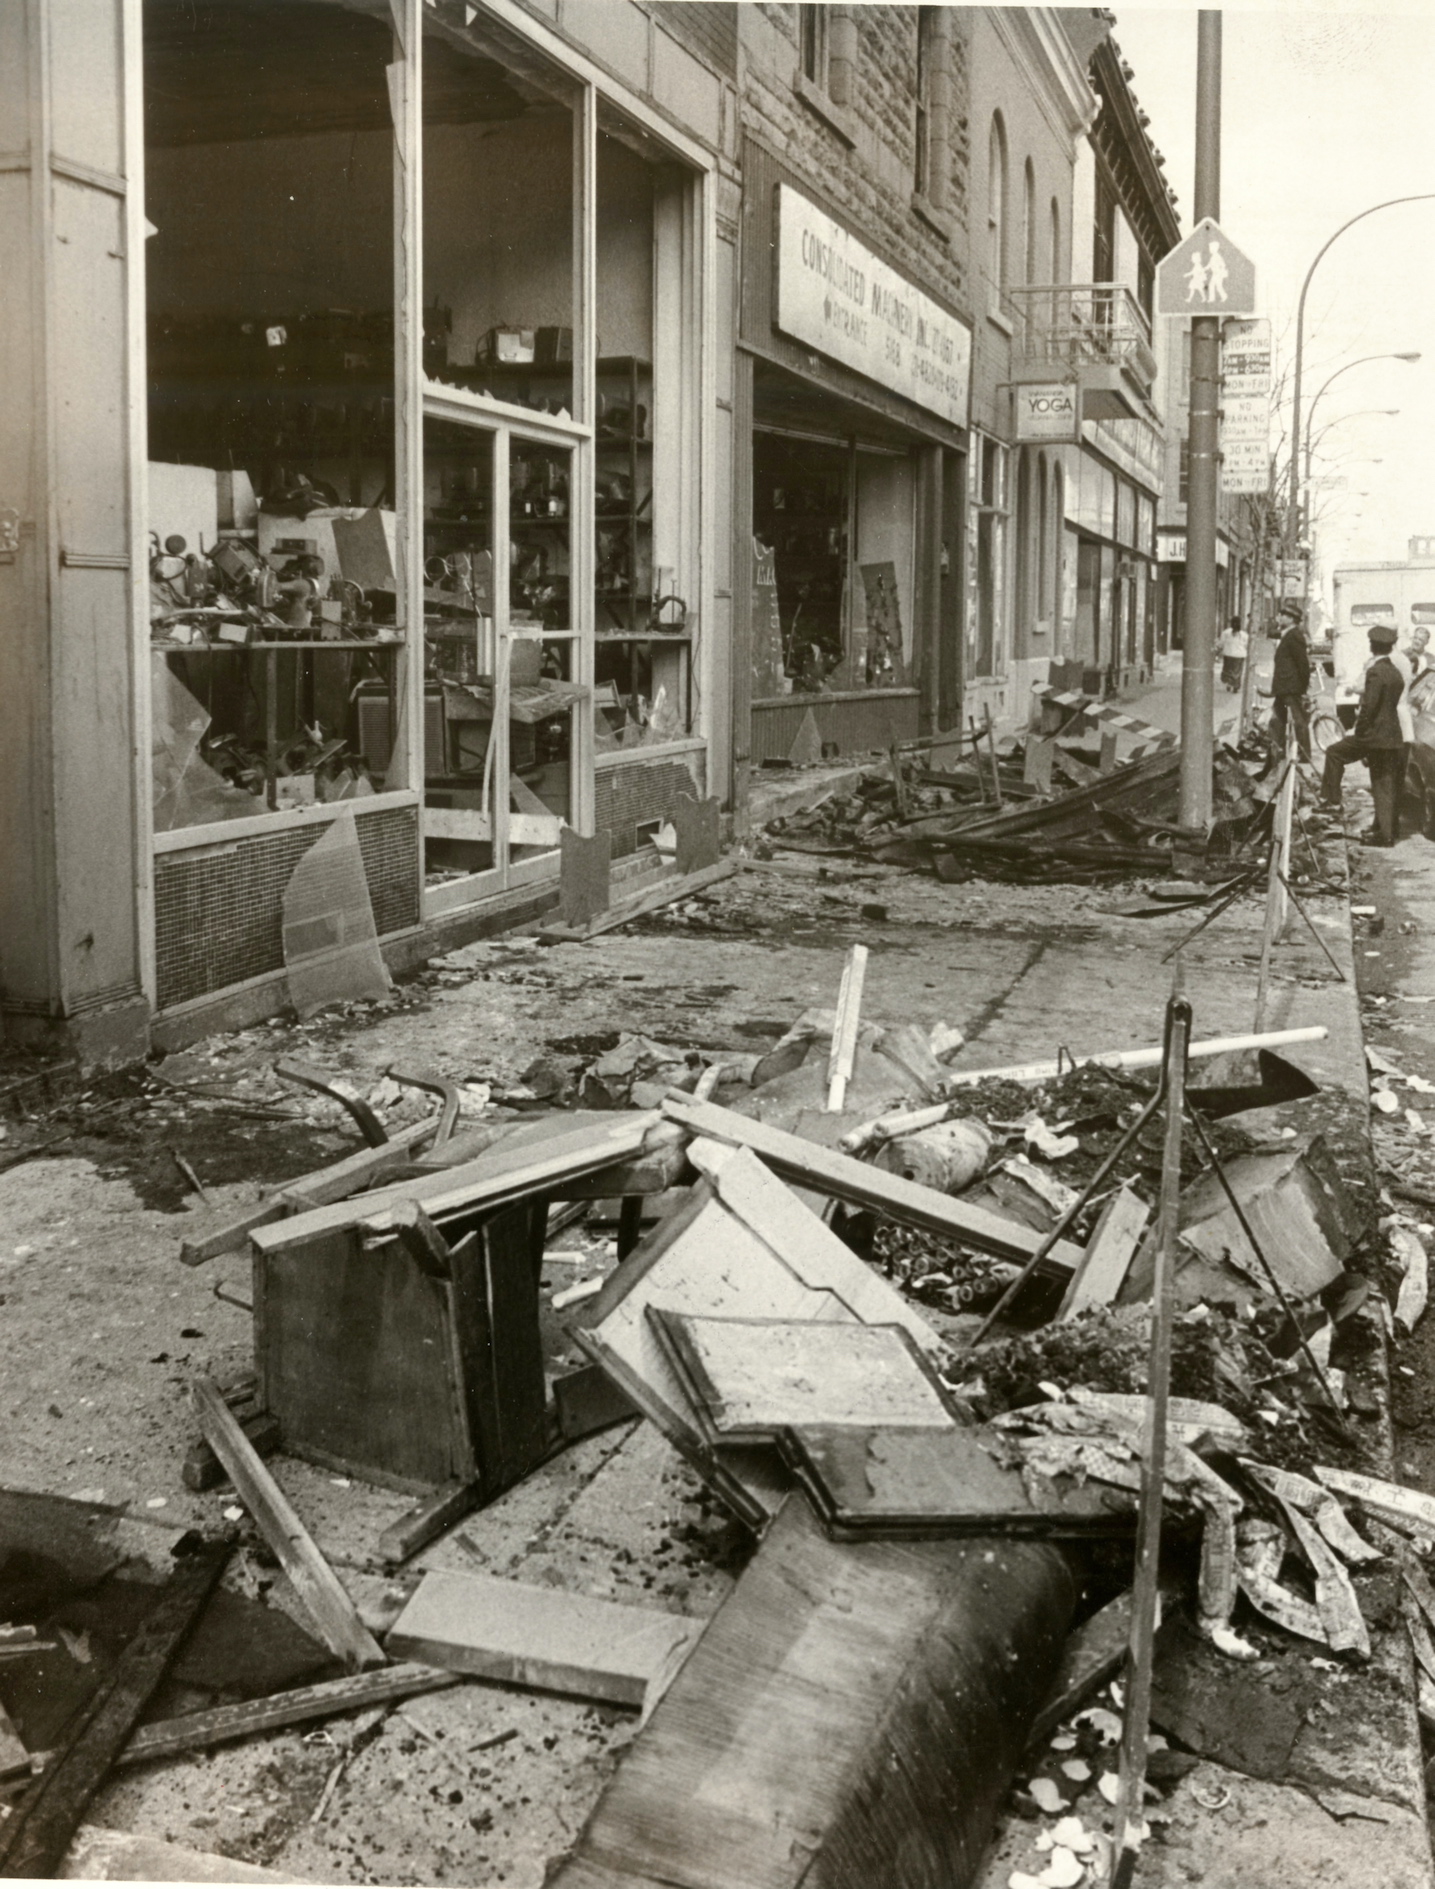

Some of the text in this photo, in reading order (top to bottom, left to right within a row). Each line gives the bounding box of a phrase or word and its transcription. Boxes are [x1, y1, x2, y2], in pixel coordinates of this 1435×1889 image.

[1240, 323, 1253, 336] NO
[1223, 338, 1270, 351] STOPPING
[1028, 397, 1073, 413] YOGA
[1239, 402, 1252, 412] NO
[1224, 413, 1265, 424] PARKING
[1244, 445, 1261, 454] MIN
[1222, 478, 1243, 488] MON
